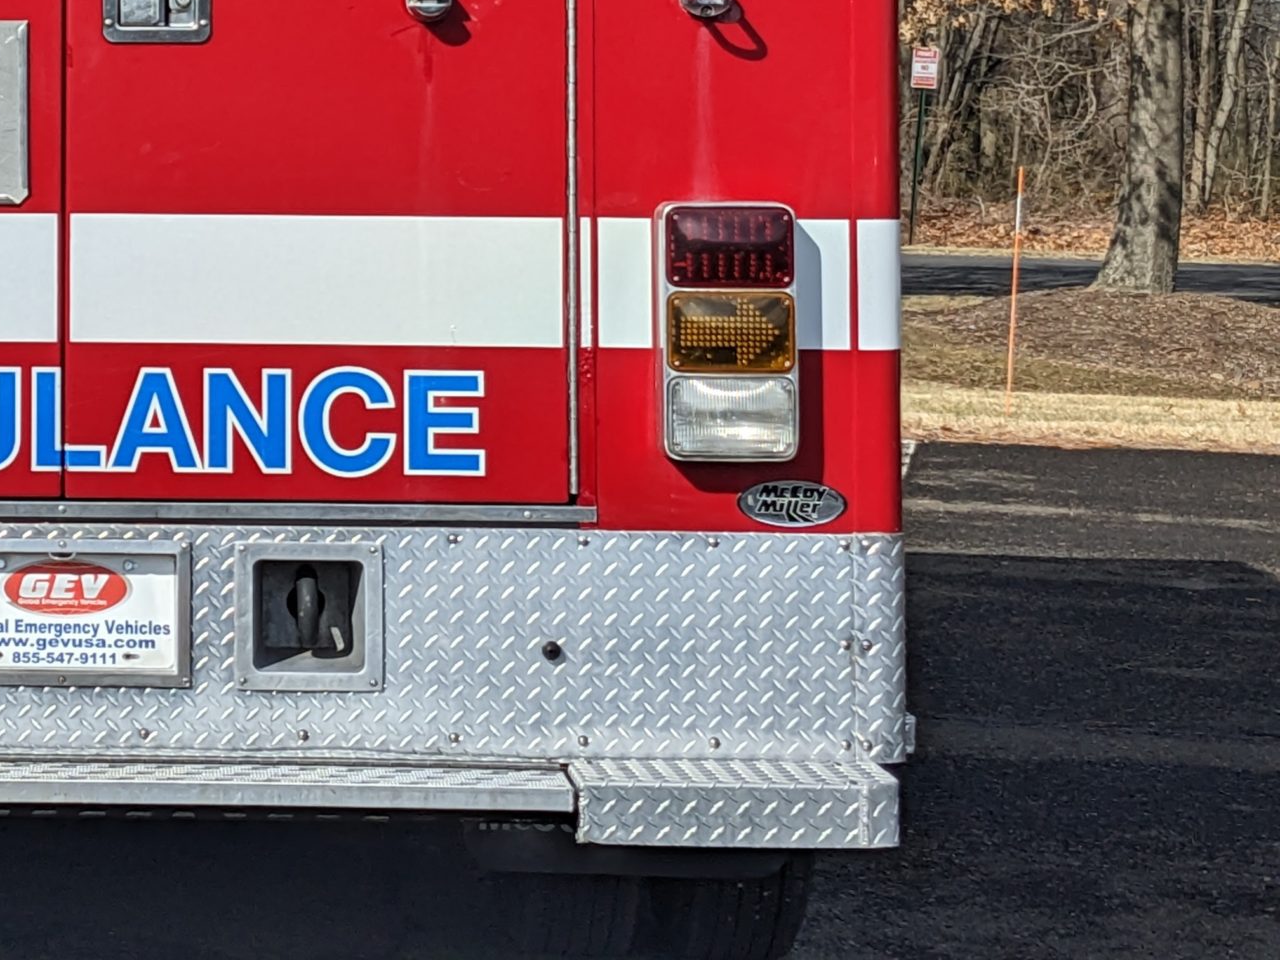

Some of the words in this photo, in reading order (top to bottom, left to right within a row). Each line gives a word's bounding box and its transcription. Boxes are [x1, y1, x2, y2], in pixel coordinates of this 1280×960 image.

[757, 485, 828, 501] McCoy
[756, 499, 822, 522] Miller
[19, 573, 110, 598] GEV
[15, 619, 100, 637] Emergency
[105, 620, 170, 635] Vehicles
[12, 651, 117, 665] 855-547-9111
